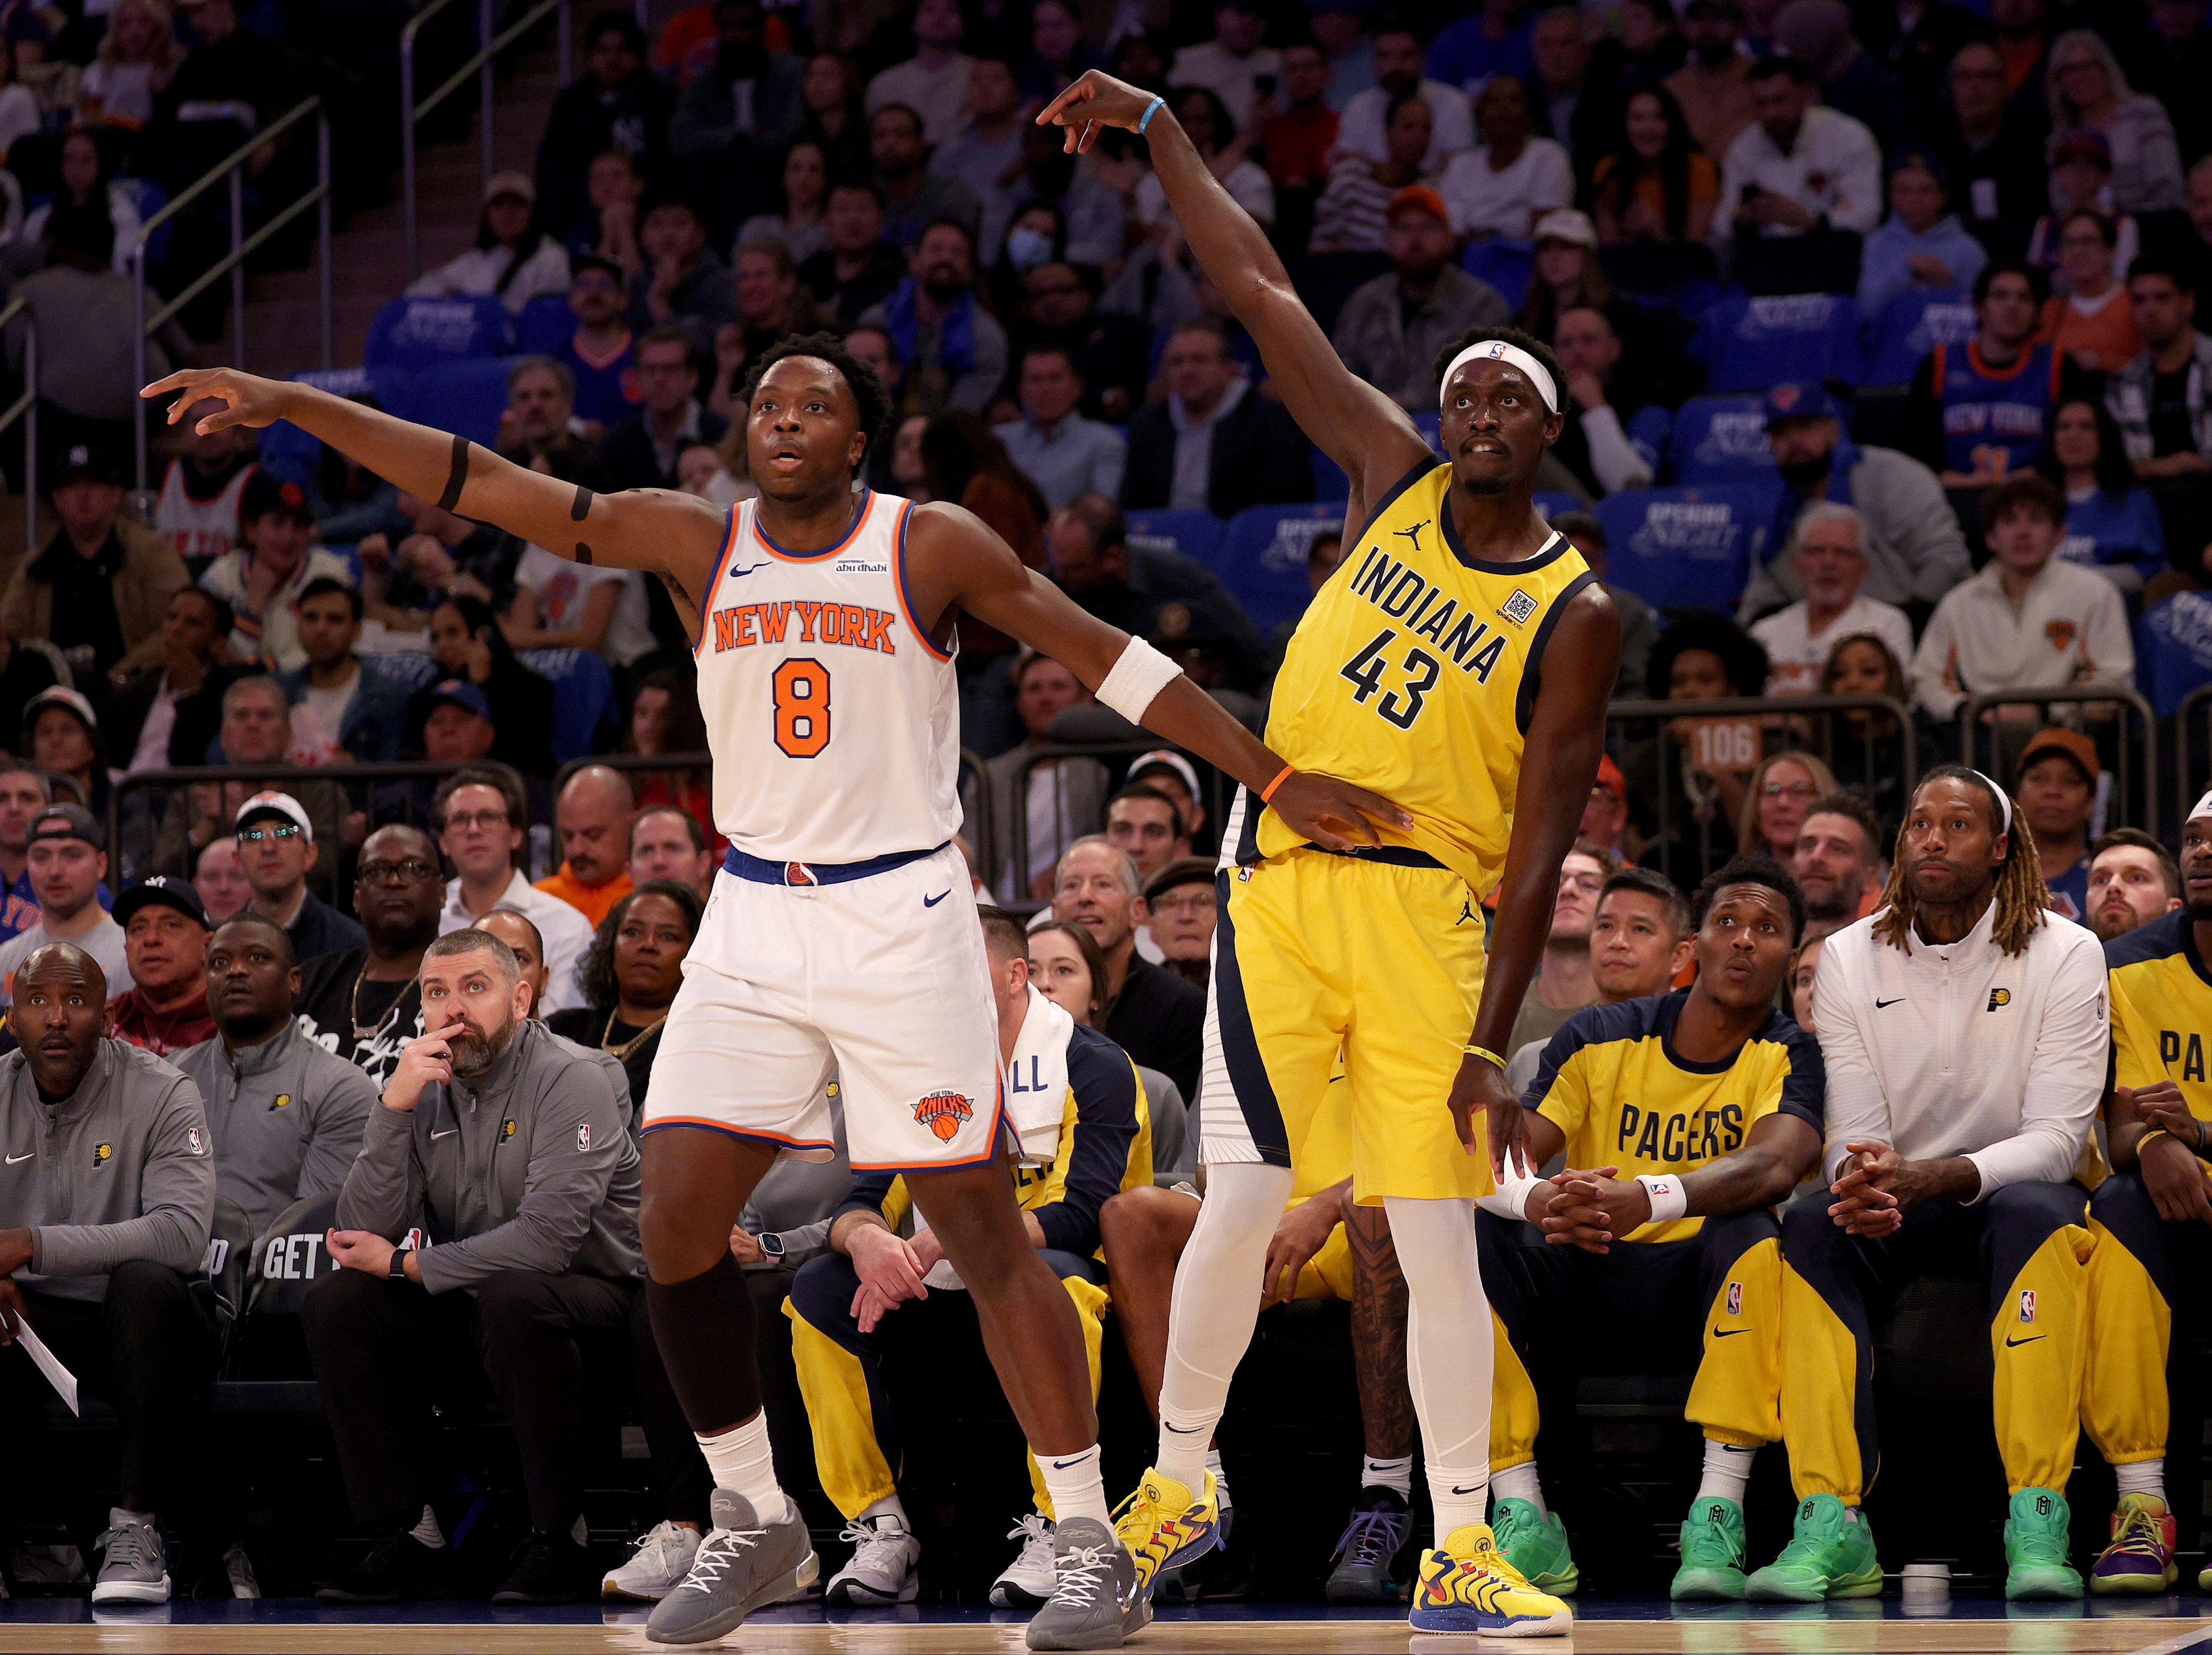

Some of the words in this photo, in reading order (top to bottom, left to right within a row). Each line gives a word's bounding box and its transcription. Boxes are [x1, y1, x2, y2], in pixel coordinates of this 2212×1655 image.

[836, 564, 855, 572] abu
[857, 564, 887, 572] dhabi
[713, 602, 792, 654] NEW
[795, 601, 896, 656] YORK
[1349, 545, 1507, 685] INDIANA
[1495, 609, 1523, 631] spokenote
[1338, 627, 1441, 730] 43
[772, 658, 831, 759] 8
[1698, 723, 1754, 765] 106
[2160, 1031, 2212, 1082] PA
[914, 1094, 973, 1121] KNICKS
[1619, 1104, 1742, 1161] PACERS
[264, 1233, 324, 1280] GET
